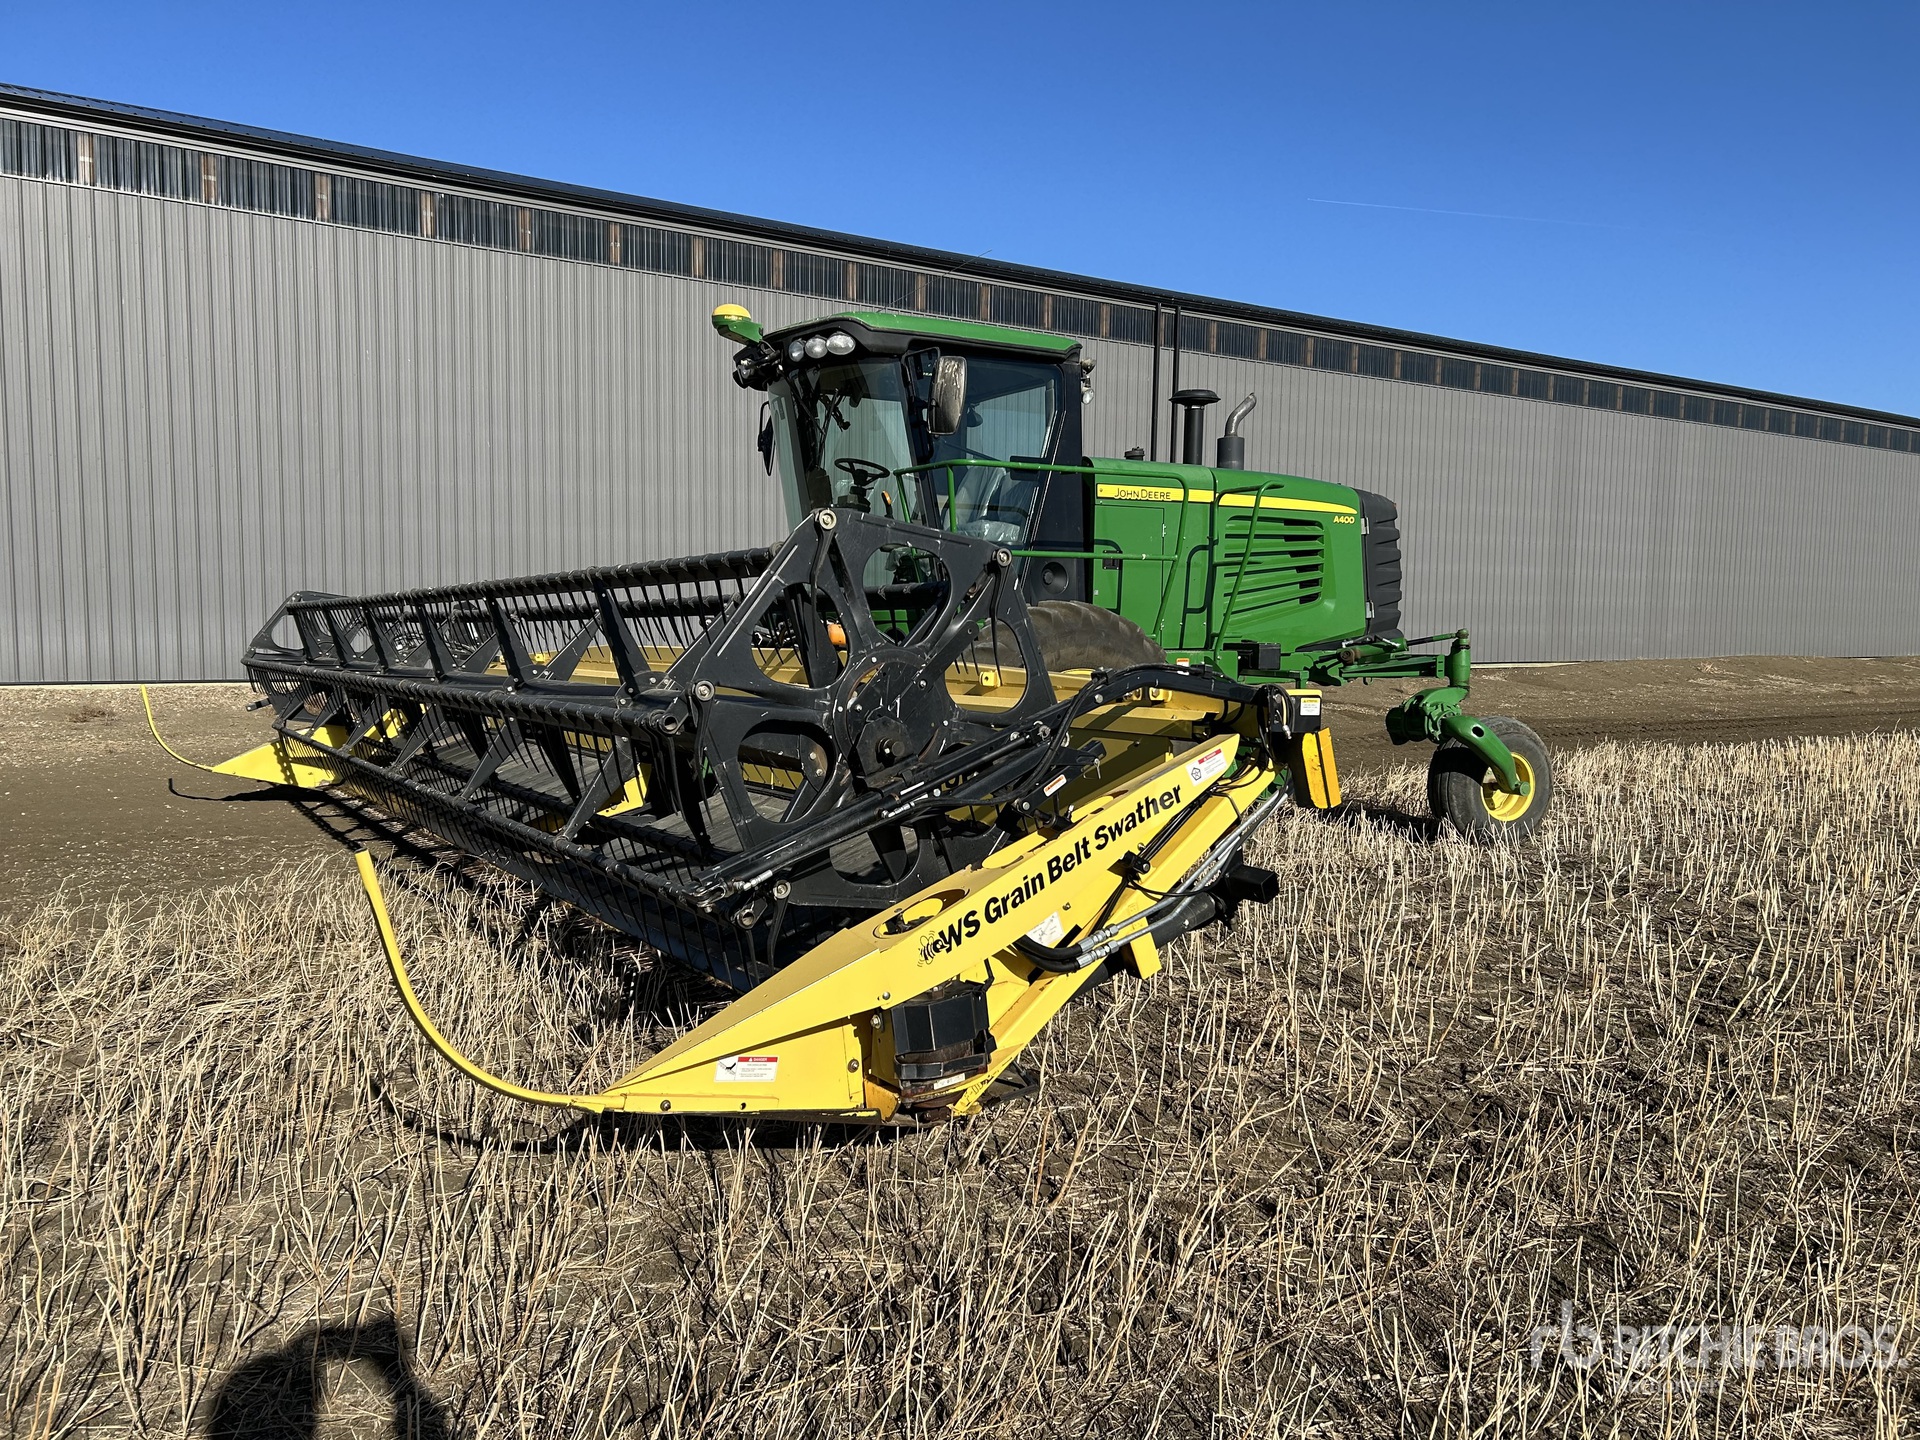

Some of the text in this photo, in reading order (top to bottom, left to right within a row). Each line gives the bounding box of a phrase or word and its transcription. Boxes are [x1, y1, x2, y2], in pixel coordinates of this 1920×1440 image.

[1333, 515, 1355, 524] A400
[984, 872, 1046, 925] Grain
[1046, 836, 1092, 884] Belt
[1094, 784, 1182, 852] Swather
